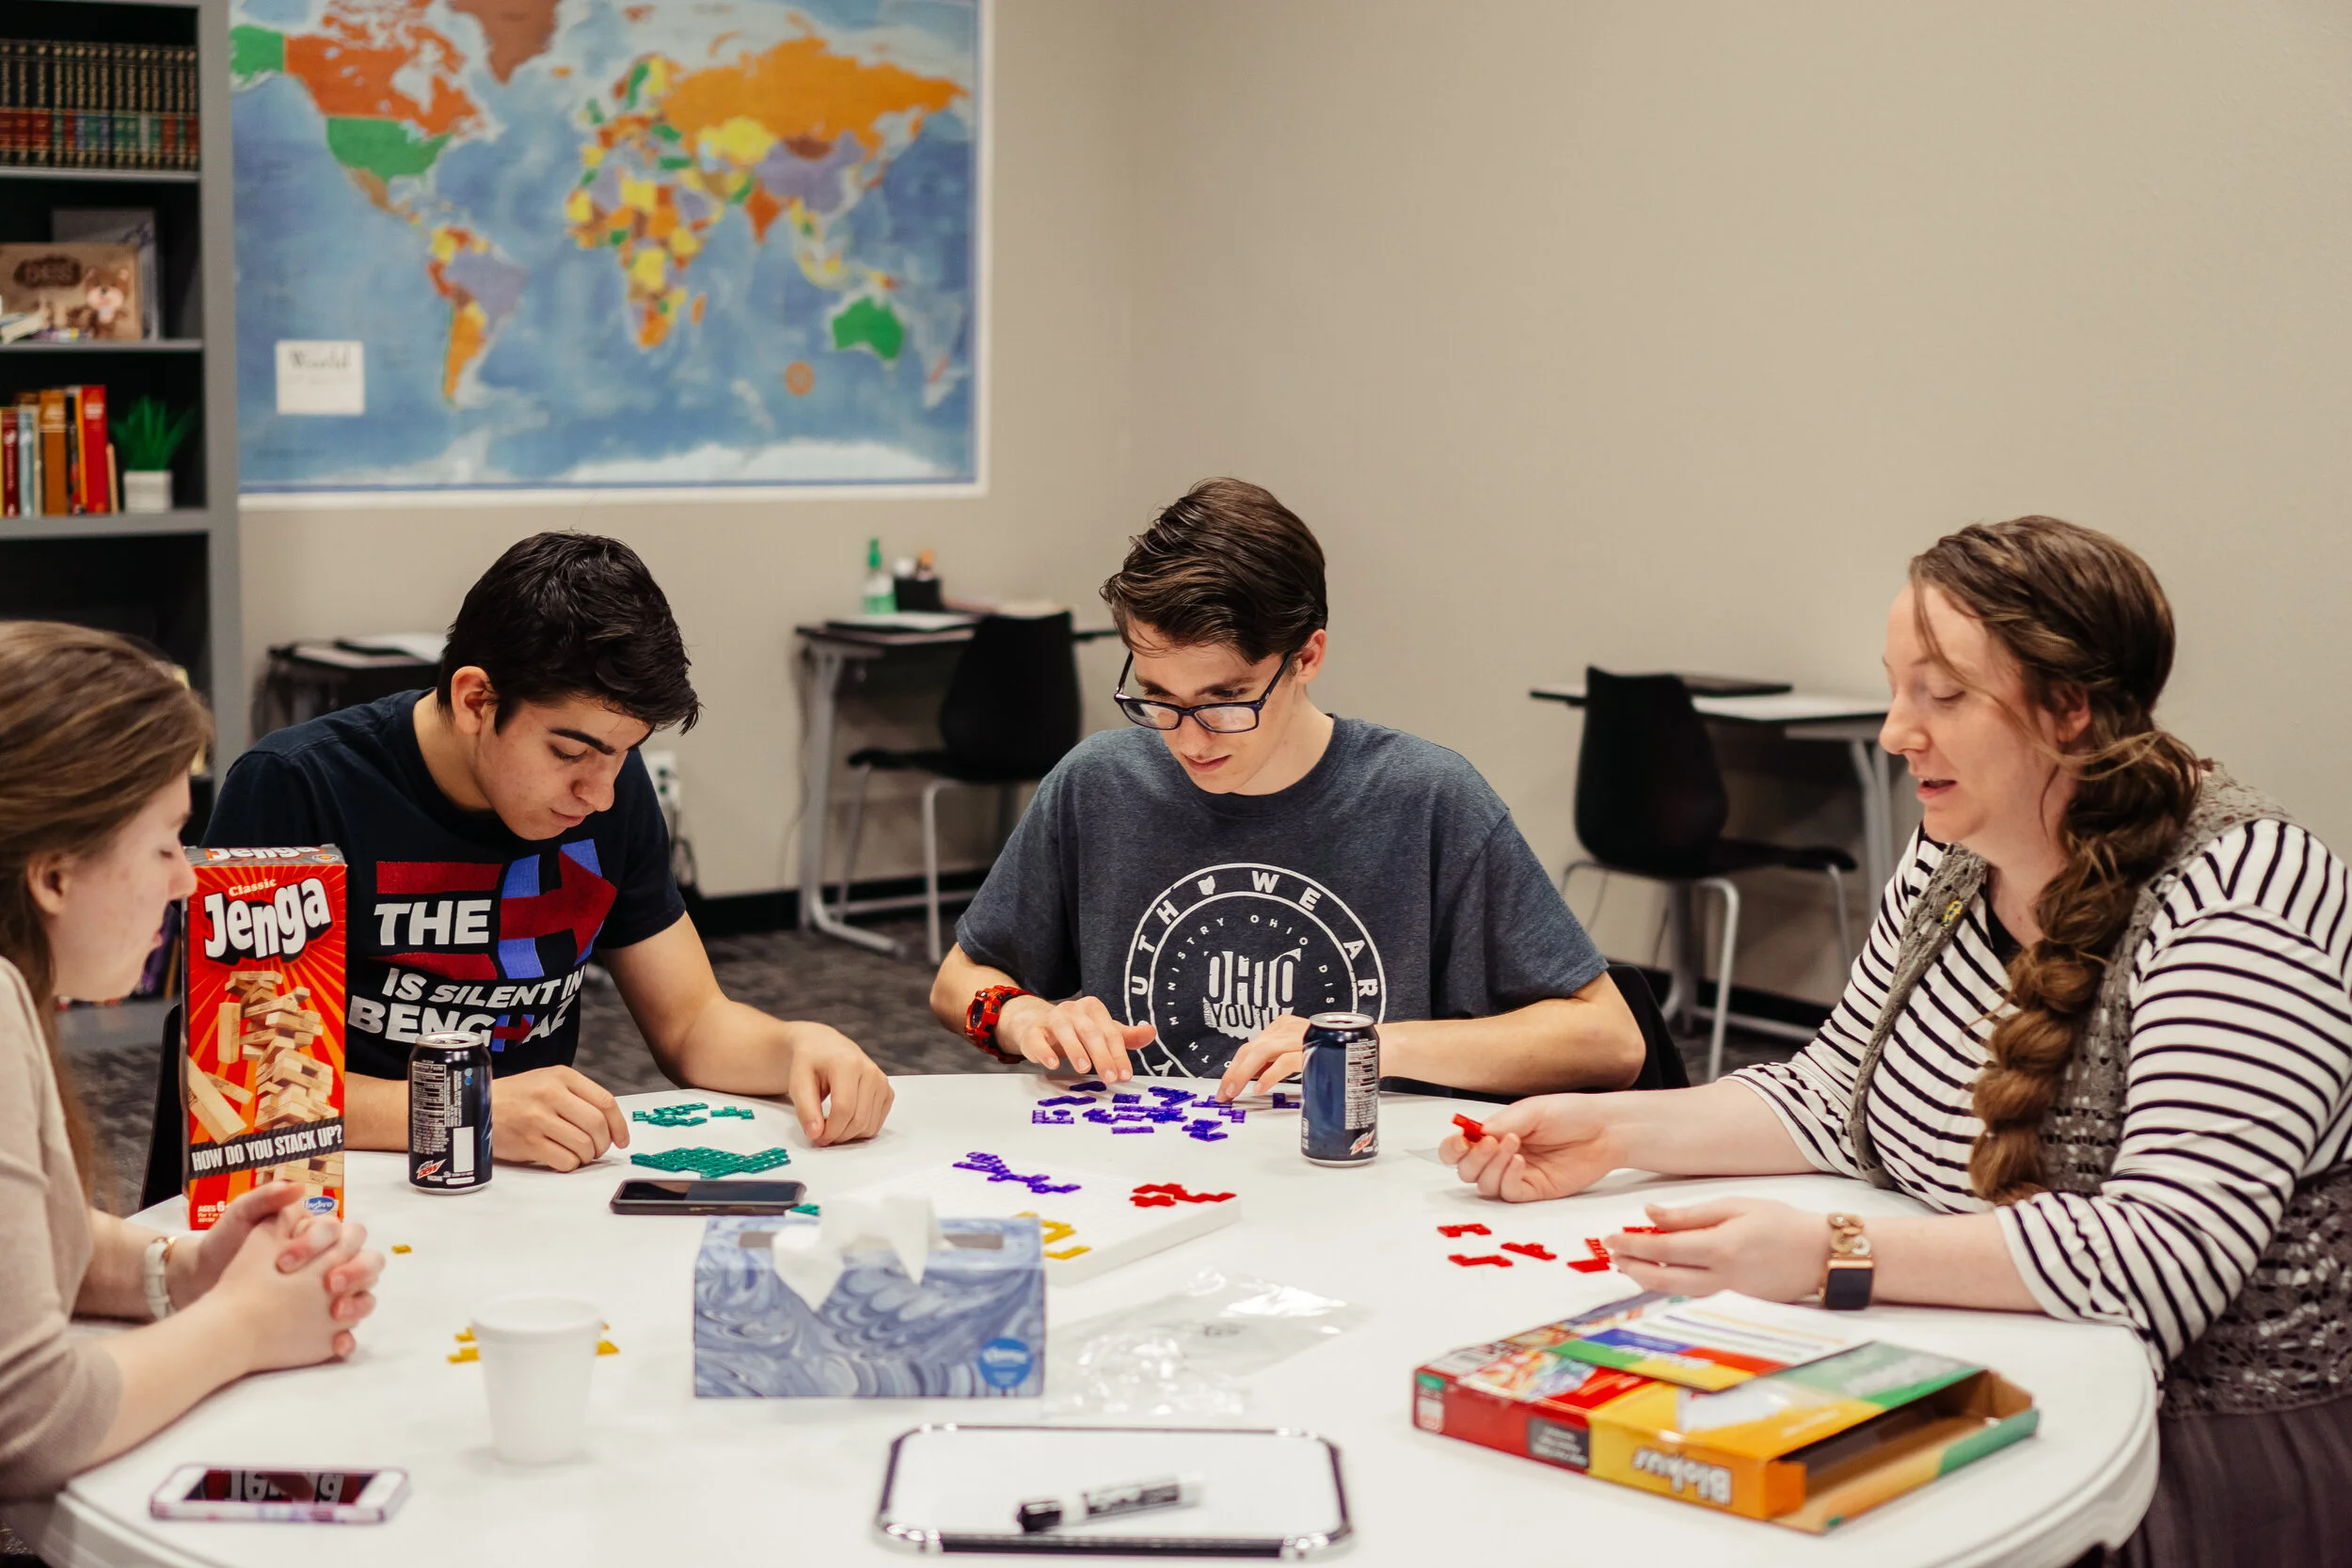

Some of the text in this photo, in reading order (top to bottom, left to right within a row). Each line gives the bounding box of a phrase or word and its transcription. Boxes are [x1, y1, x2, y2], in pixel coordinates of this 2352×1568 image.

[210, 847, 320, 860] Jenga
[228, 878, 278, 897] Classic
[204, 878, 331, 958] Jenga
[373, 899, 492, 945] THE
[381, 964, 585, 1008] IS SILENT IN
[191, 1124, 342, 1172] HOW DO YOU STACK UP?
[198, 1205, 216, 1213] AGES
